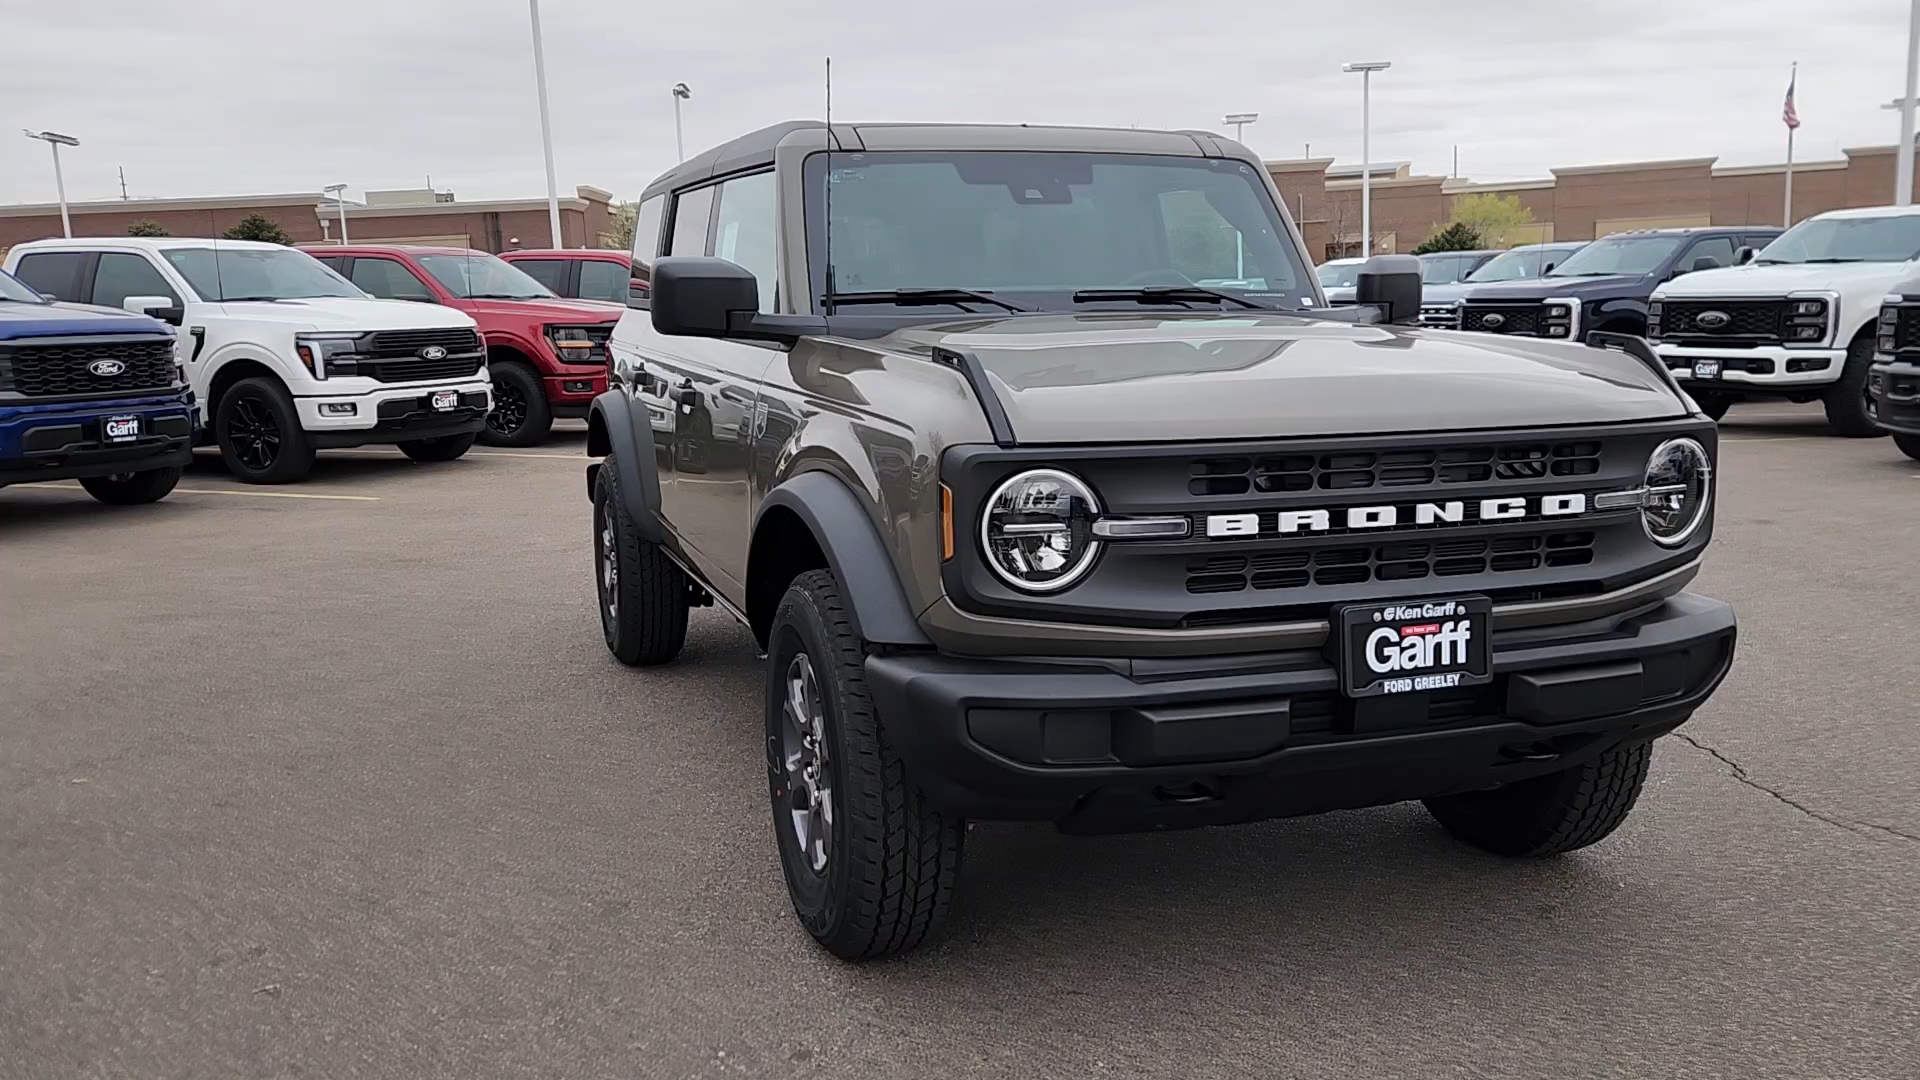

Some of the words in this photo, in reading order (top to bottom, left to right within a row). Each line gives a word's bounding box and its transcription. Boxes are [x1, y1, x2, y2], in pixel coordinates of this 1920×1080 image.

[97, 362, 119, 373] Ford
[431, 393, 458, 408] Garff
[106, 420, 138, 436] Garff
[1206, 493, 1586, 537] BRONCO
[1395, 605, 1421, 620] Ken
[1422, 602, 1456, 617] Garff
[1365, 619, 1471, 673] Garff
[1383, 678, 1413, 694] FORD
[1414, 673, 1461, 692] GREELEY
